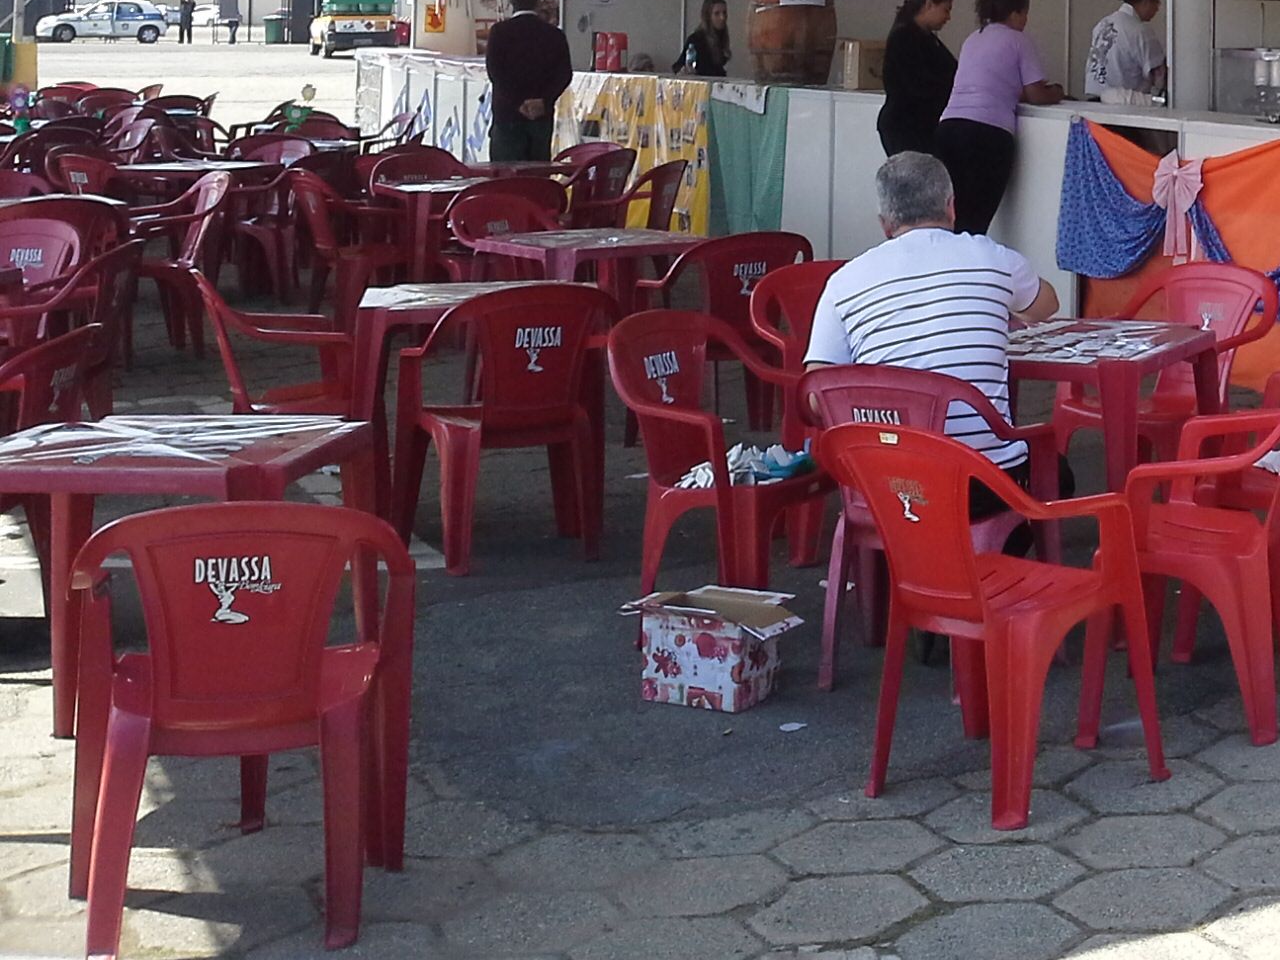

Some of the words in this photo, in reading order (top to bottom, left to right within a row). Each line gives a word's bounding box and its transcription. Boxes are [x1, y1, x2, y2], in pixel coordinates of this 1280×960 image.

[10, 248, 43, 262] DEVASSA
[733, 261, 767, 277] DEVASSA
[515, 326, 562, 349] DEVASSA
[643, 350, 680, 380] DEVASSA
[853, 407, 900, 425] DEVASSA
[194, 555, 272, 584] DEVASSA
